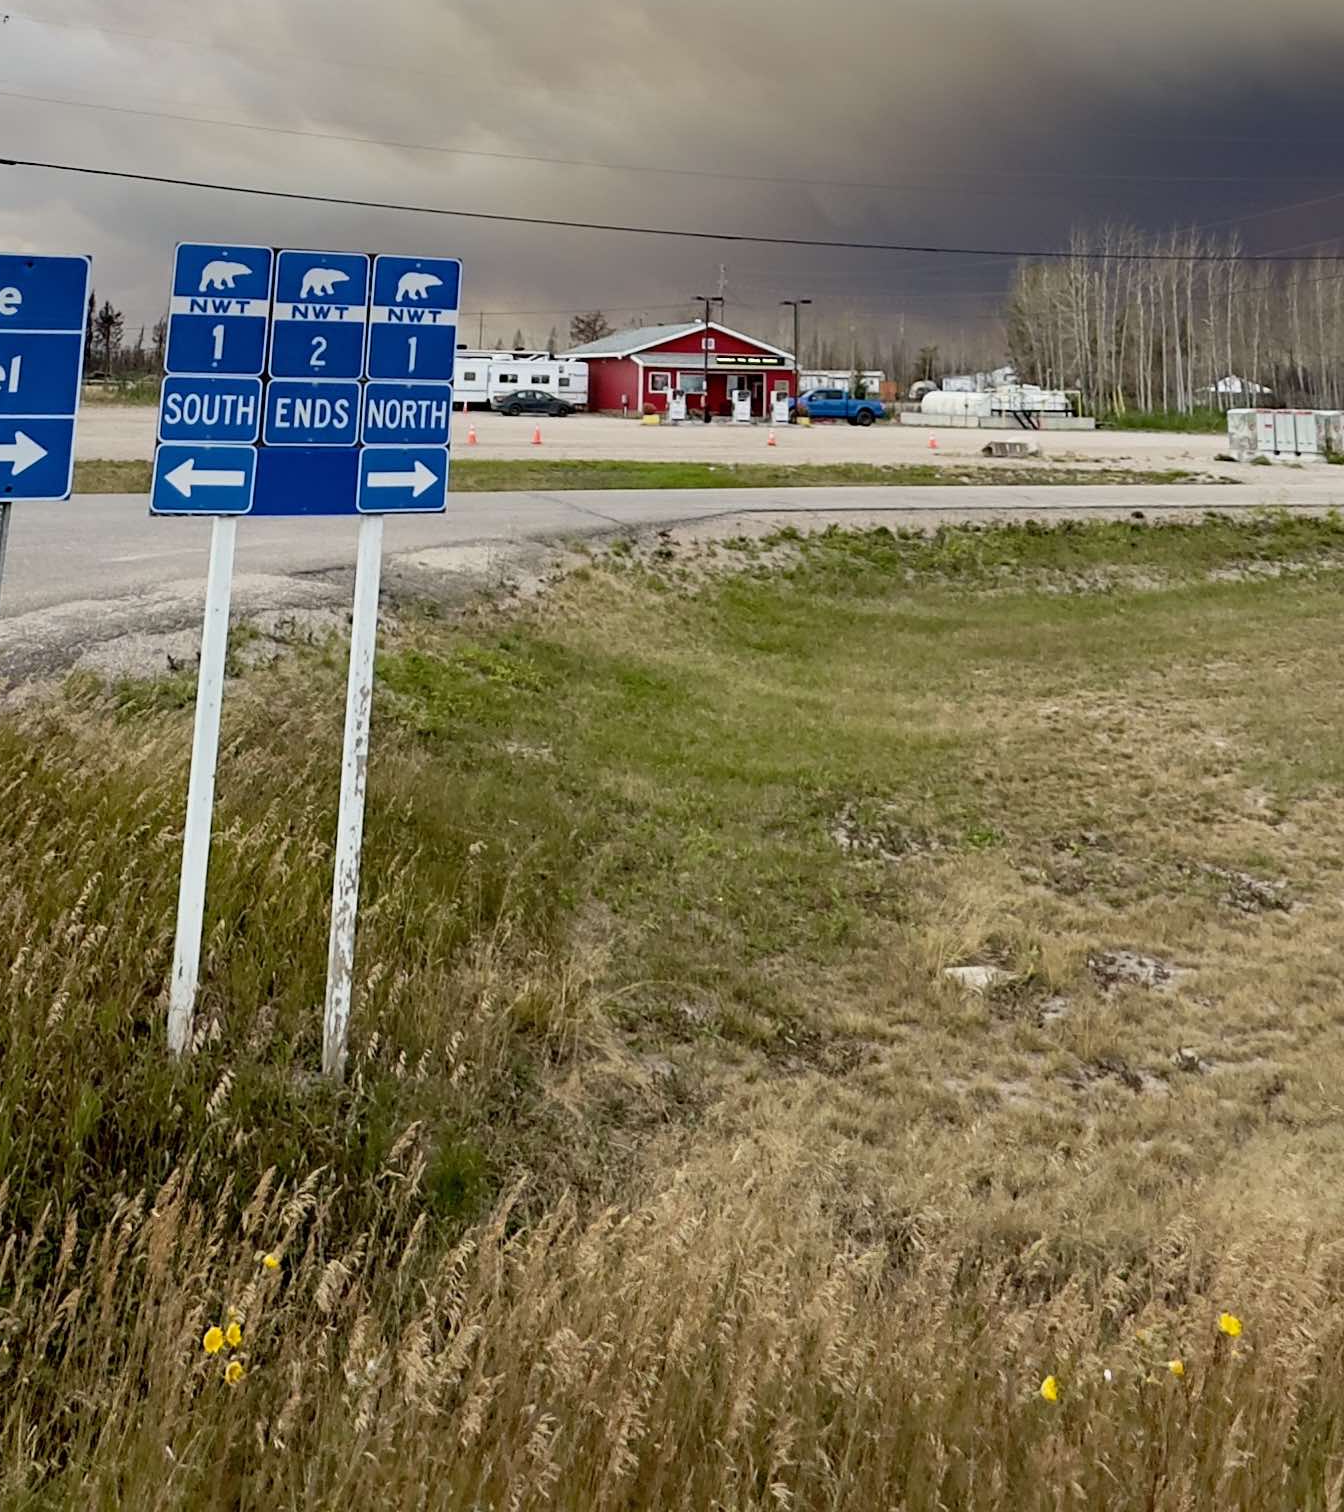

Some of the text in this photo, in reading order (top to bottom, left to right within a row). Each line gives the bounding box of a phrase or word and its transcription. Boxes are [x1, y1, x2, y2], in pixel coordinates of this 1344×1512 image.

[189, 298, 251, 314] NWT
[291, 304, 350, 320] NWT
[387, 307, 442, 323] NWT
[212, 324, 225, 361] 1
[309, 336, 327, 367] 2
[408, 336, 418, 373] 1
[165, 392, 256, 426] SOUTH
[274, 397, 350, 429] ENDS
[367, 399, 447, 429] NORTH
